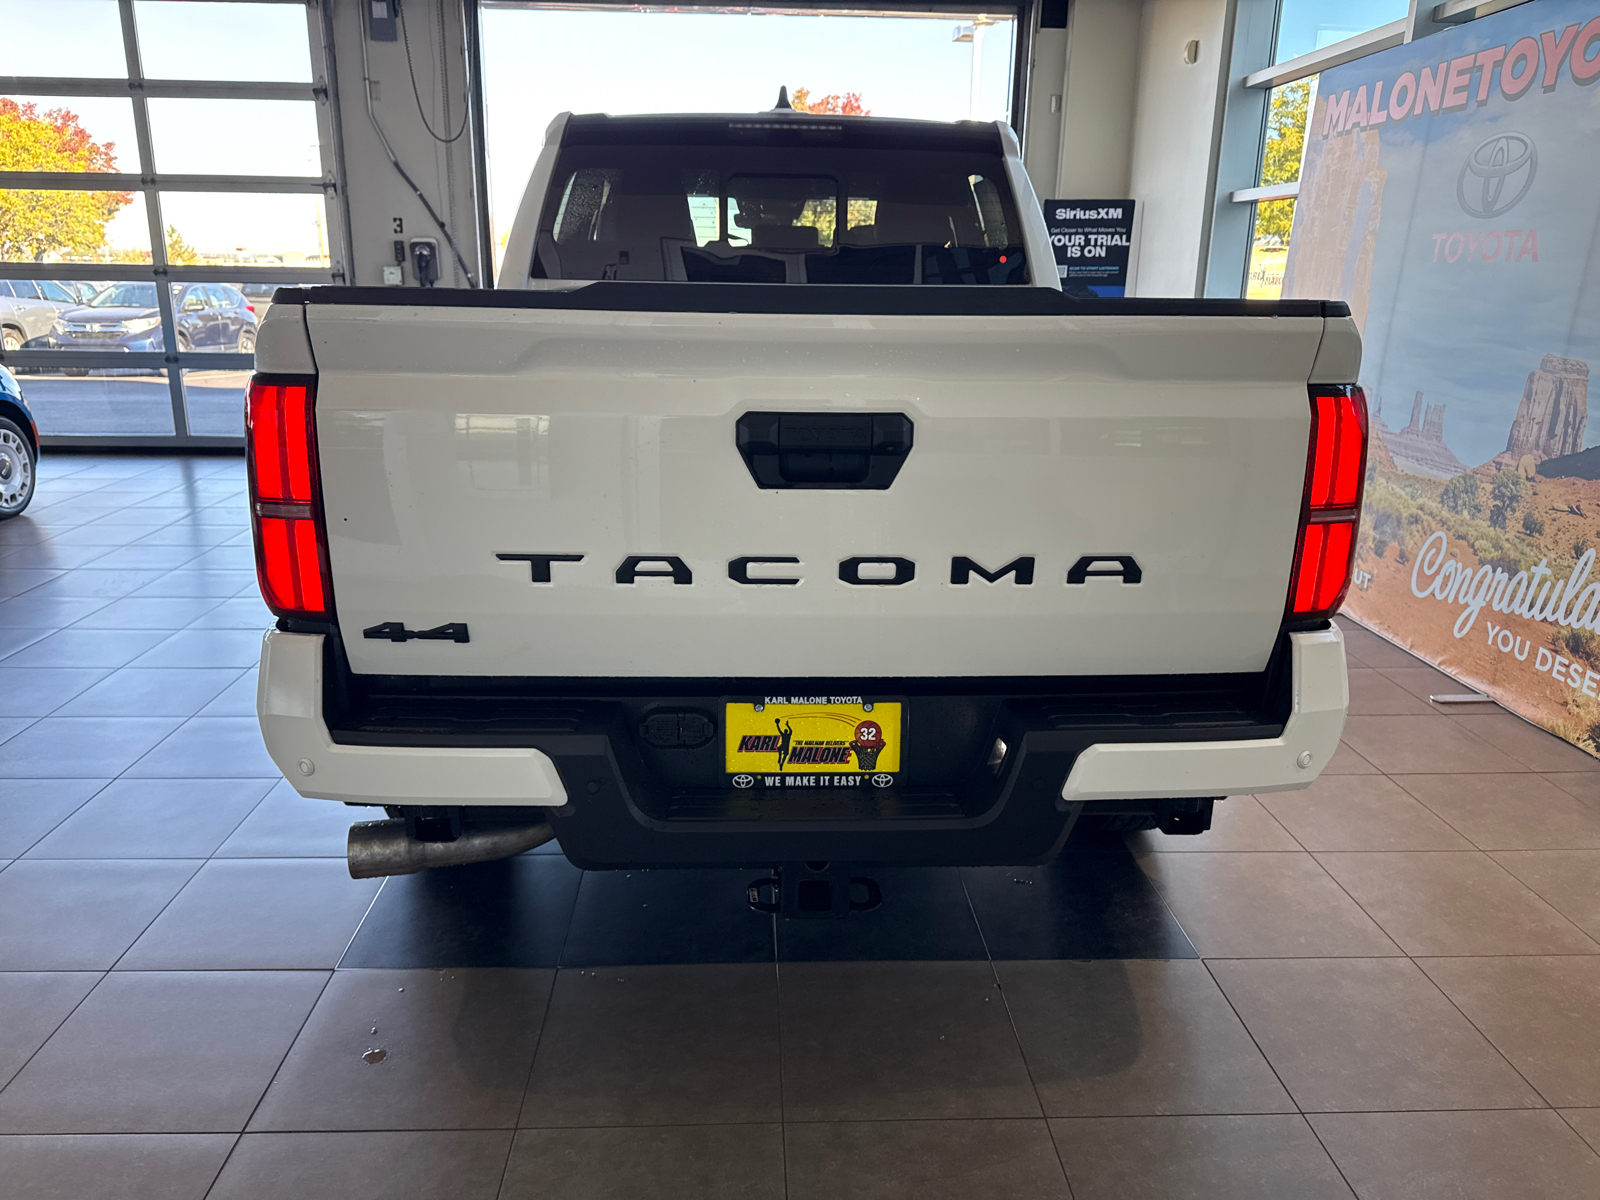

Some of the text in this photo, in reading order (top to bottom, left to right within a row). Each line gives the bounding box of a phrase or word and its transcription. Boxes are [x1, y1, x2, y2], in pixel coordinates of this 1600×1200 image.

[1055, 208, 1123, 220] SiriusXM
[393, 217, 403, 234] 3
[1088, 234, 1130, 246] TRIAL
[1432, 229, 1539, 263] TOYOTA
[1067, 246, 1106, 257] IS ON
[495, 554, 1142, 586] TACOMA
[1411, 531, 1600, 639] Congratula
[1487, 621, 1600, 701] YOU DESE
[764, 696, 863, 705] KARL MALONE TOYOTA
[860, 727, 876, 741] 32
[737, 735, 781, 753] KARL
[787, 746, 851, 764] MALONE
[764, 776, 862, 786] WE MAKE IT EASY
